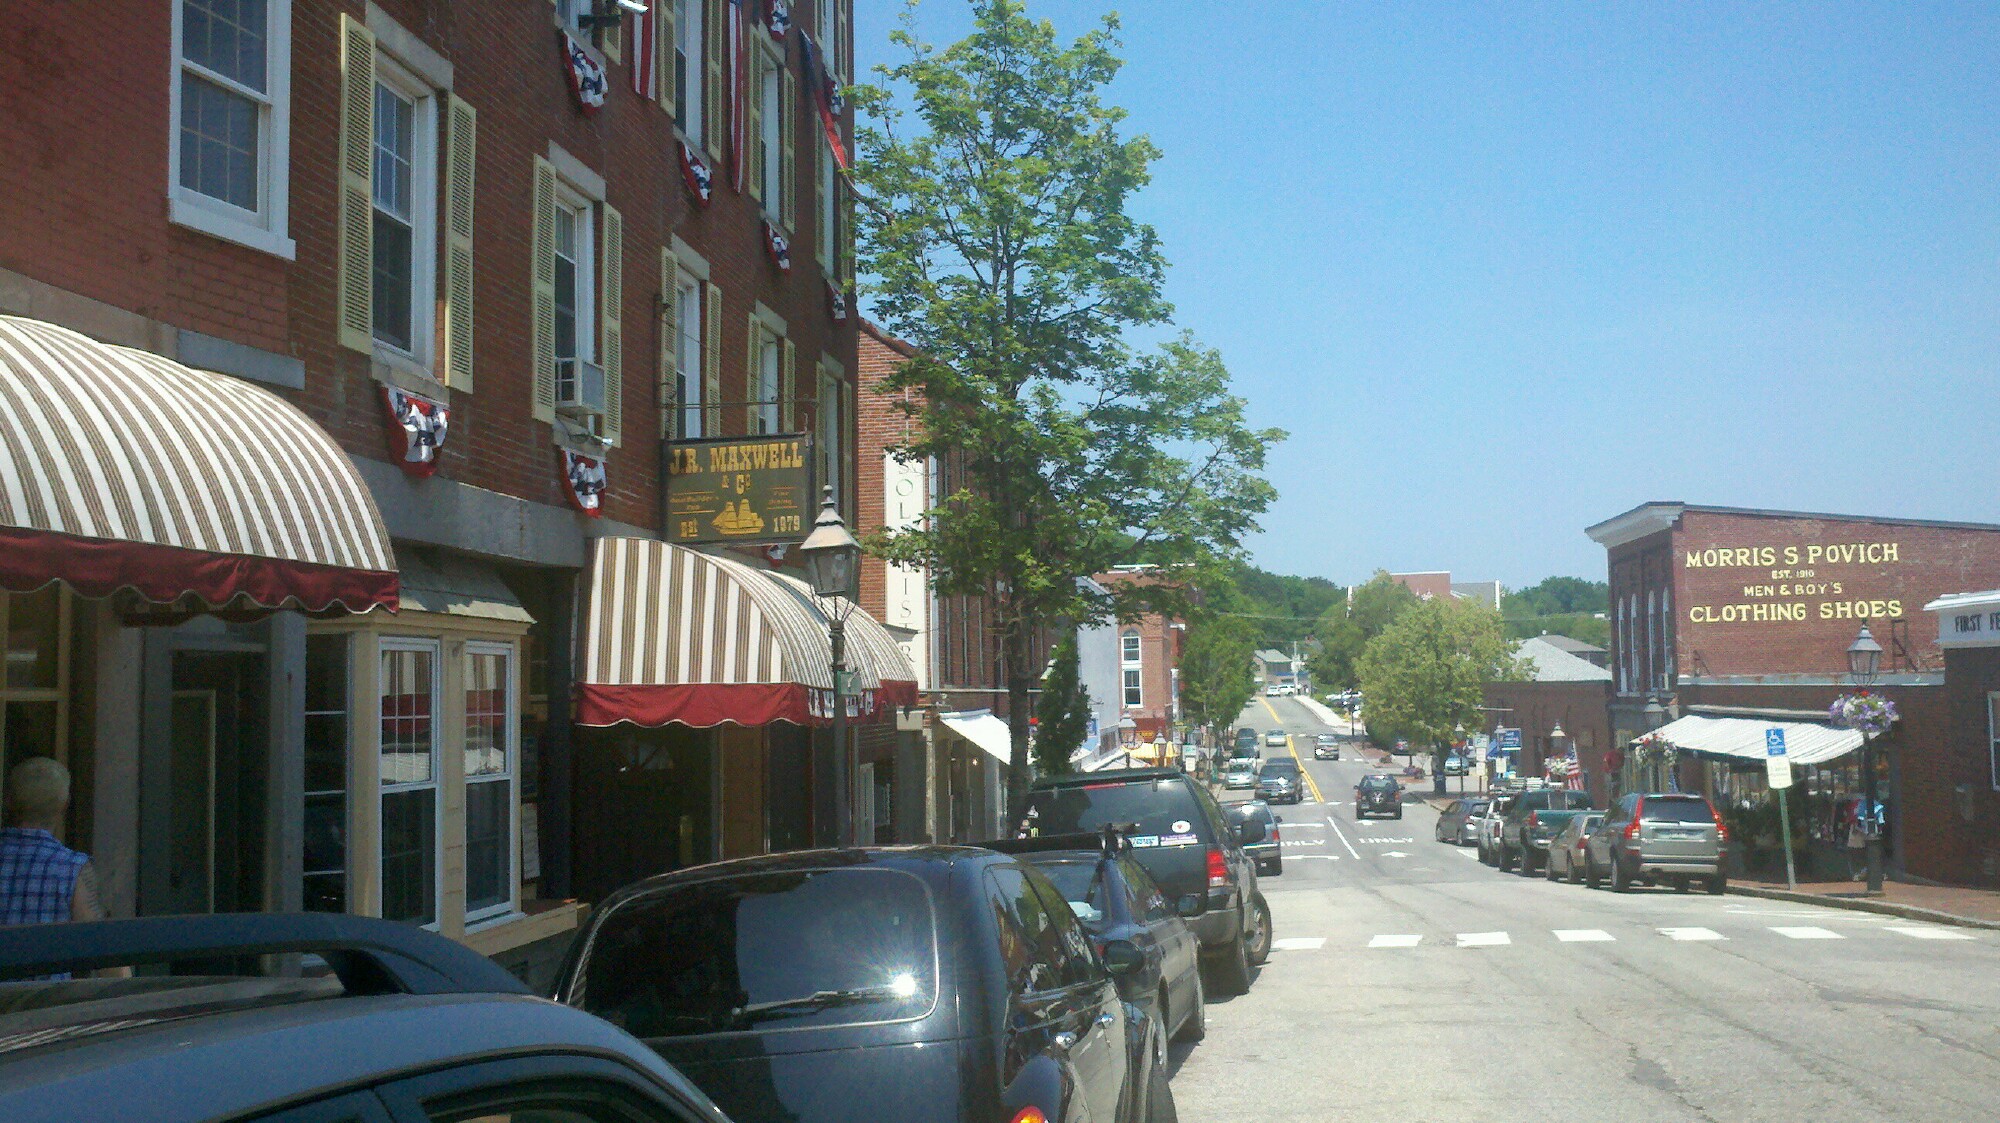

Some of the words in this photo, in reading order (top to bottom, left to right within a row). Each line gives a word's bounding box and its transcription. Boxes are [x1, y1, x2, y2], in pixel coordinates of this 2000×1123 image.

[710, 441, 803, 473] MAXWELL
[721, 475, 730, 489] &
[895, 462, 914, 524] SOL
[773, 515, 801, 533] 1979
[1686, 546, 1776, 568] MORRIS
[1784, 546, 1799, 566] S
[1807, 543, 1899, 565] POVICH
[1796, 569, 1814, 579] 1910
[1743, 585, 1774, 597] MEN
[1779, 584, 1791, 596] &
[1795, 582, 1843, 596] BOY'S
[1689, 602, 1807, 623] CLOTHING
[1820, 600, 1903, 620] SHOES
[1955, 613, 1982, 633] FIRST
